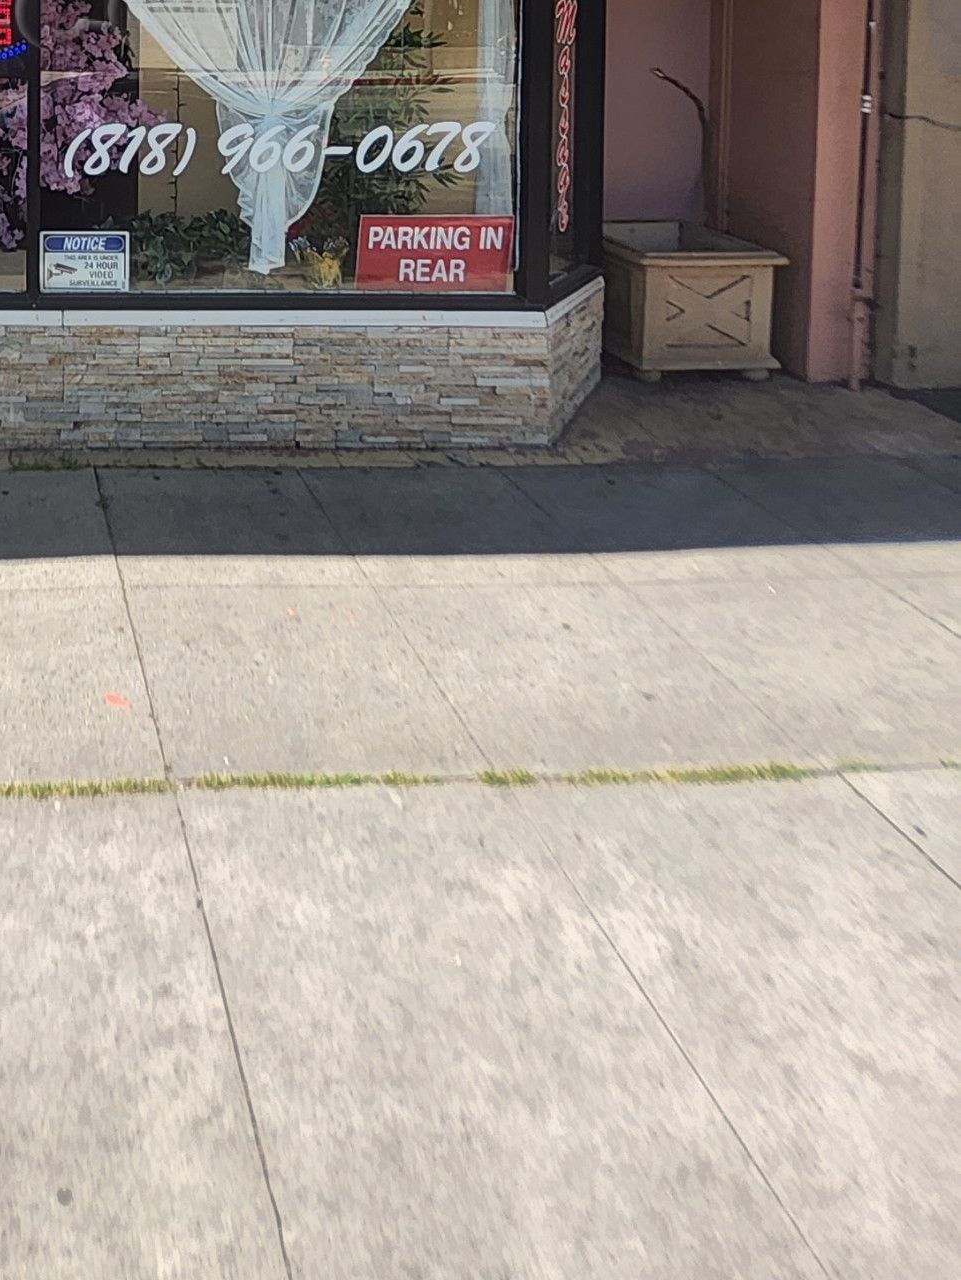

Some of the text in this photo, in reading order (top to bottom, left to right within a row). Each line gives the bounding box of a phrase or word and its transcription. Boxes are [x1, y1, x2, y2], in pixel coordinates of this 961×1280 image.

[64, 121, 496, 178] (818) 966-0678
[63, 236, 108, 251] NOTICE
[367, 226, 504, 251] PARKING IN
[84, 261, 119, 270] 24 HOUR
[89, 271, 114, 279] VIDEO
[398, 258, 467, 282] REAR
